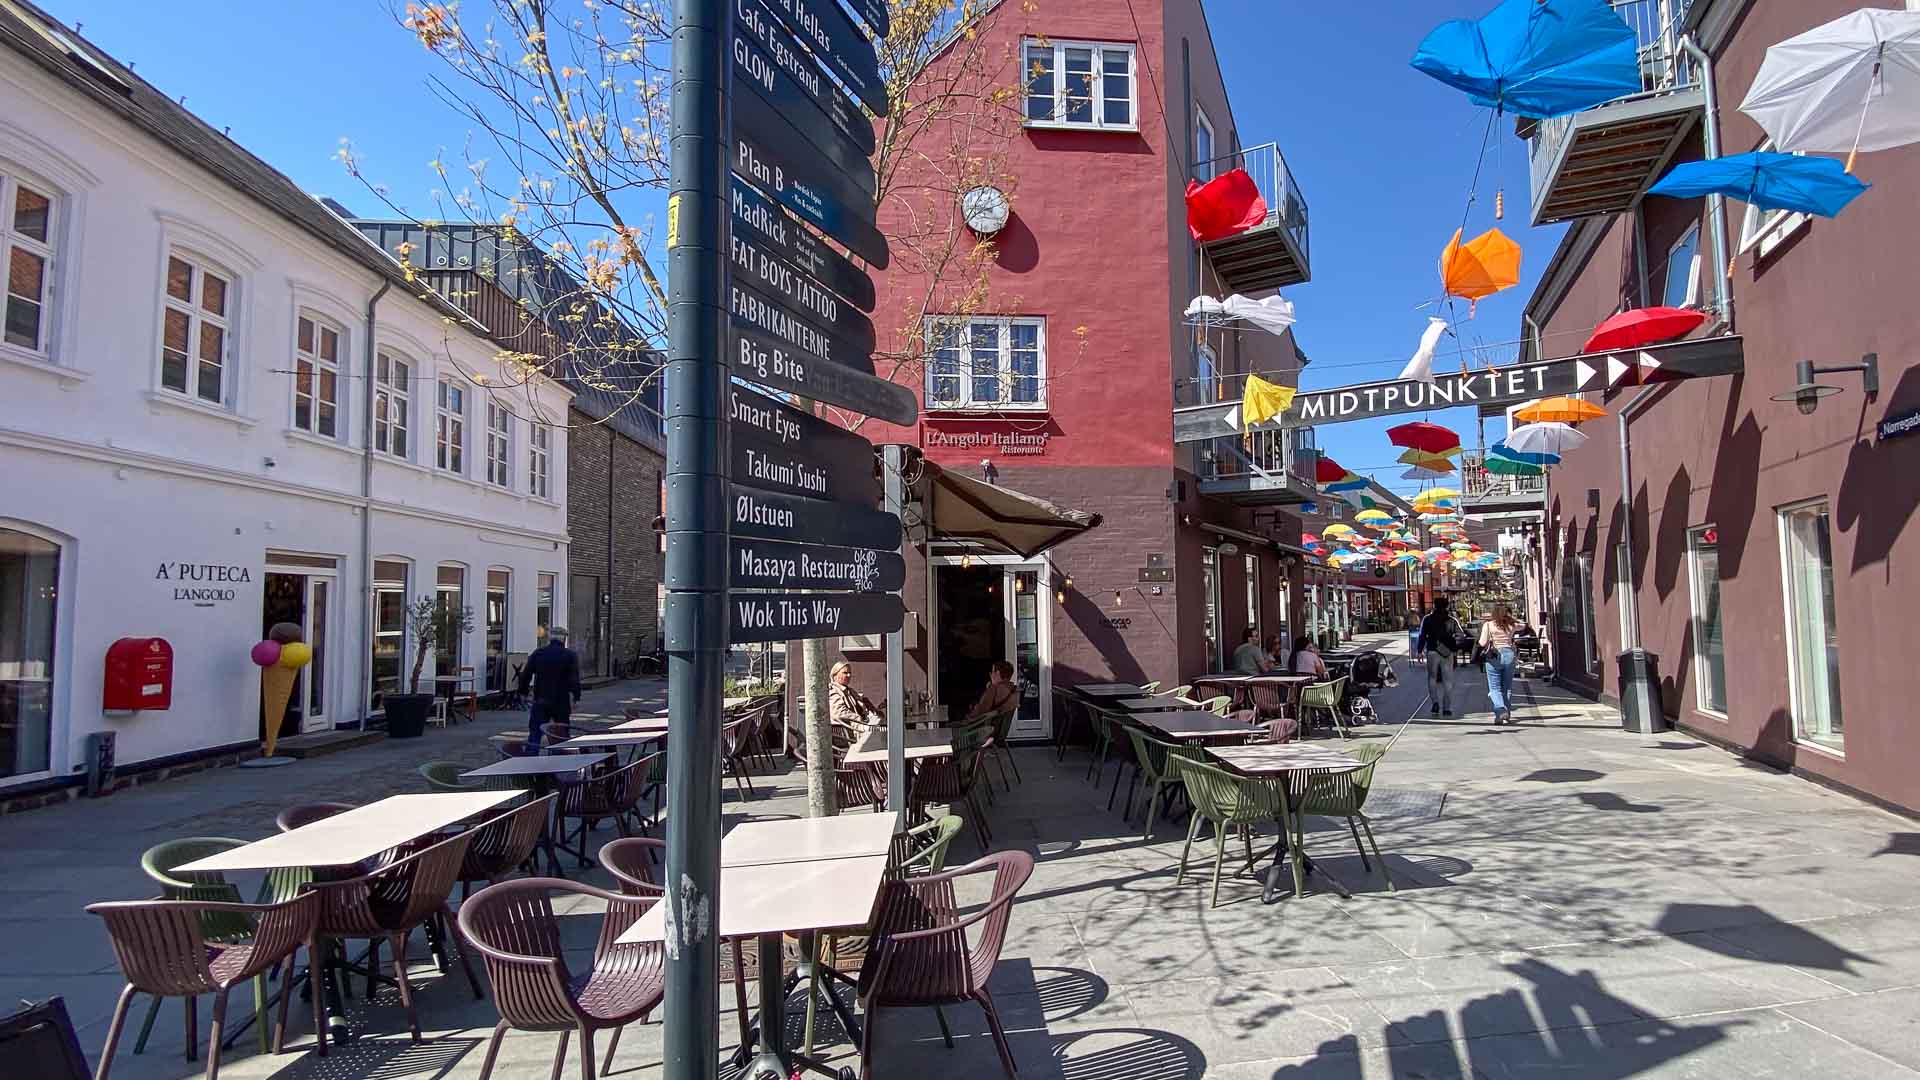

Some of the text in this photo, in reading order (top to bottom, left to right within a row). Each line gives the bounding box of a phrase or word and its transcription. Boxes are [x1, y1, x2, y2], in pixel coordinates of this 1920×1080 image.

[796, 0, 830, 52] Hellas
[735, 38, 775, 92] GLOW
[770, 26, 819, 97] Egstrand
[739, 140, 784, 192] Plan B
[732, 187, 787, 248] MadRick
[731, 235, 756, 272] FAT
[760, 254, 792, 295] BOYS
[795, 276, 837, 322] TATTOO
[732, 287, 831, 361] FABRIKANTERNE
[740, 338, 768, 377] Big
[773, 348, 804, 382] Bite
[1300, 366, 1549, 419] MIDTPUNKTET
[731, 391, 801, 443] Smart Eyes
[926, 432, 989, 448] L'Angolo
[746, 449, 826, 493] Takumi Sushi
[1000, 445, 1043, 454] Ristorante
[736, 495, 793, 528] Ølstuen
[180, 563, 250, 582] PUTECA
[741, 549, 868, 584] Masaya Restaurant
[174, 588, 235, 601] L'ANGOLO
[739, 600, 840, 630] Wok This Way
